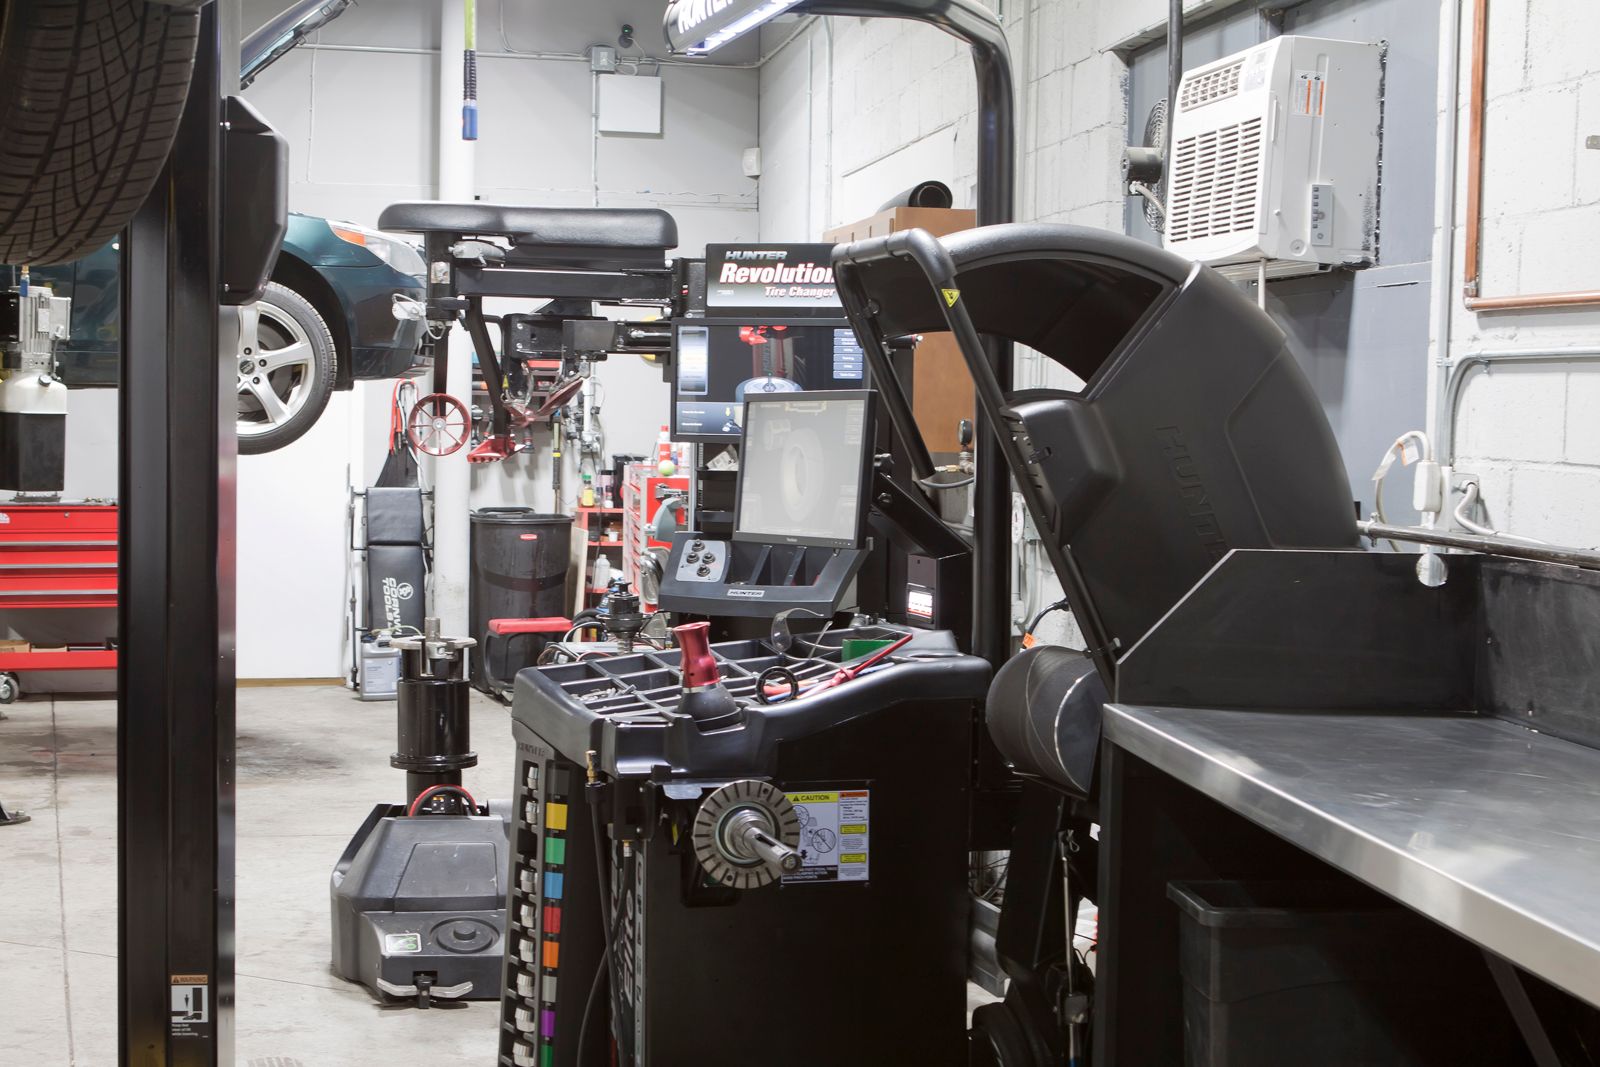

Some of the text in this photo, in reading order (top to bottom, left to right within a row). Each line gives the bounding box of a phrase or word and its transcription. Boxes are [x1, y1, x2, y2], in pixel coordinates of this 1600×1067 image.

[725, 251, 788, 260] HUNTER
[765, 286, 835, 300] Tire Changer
